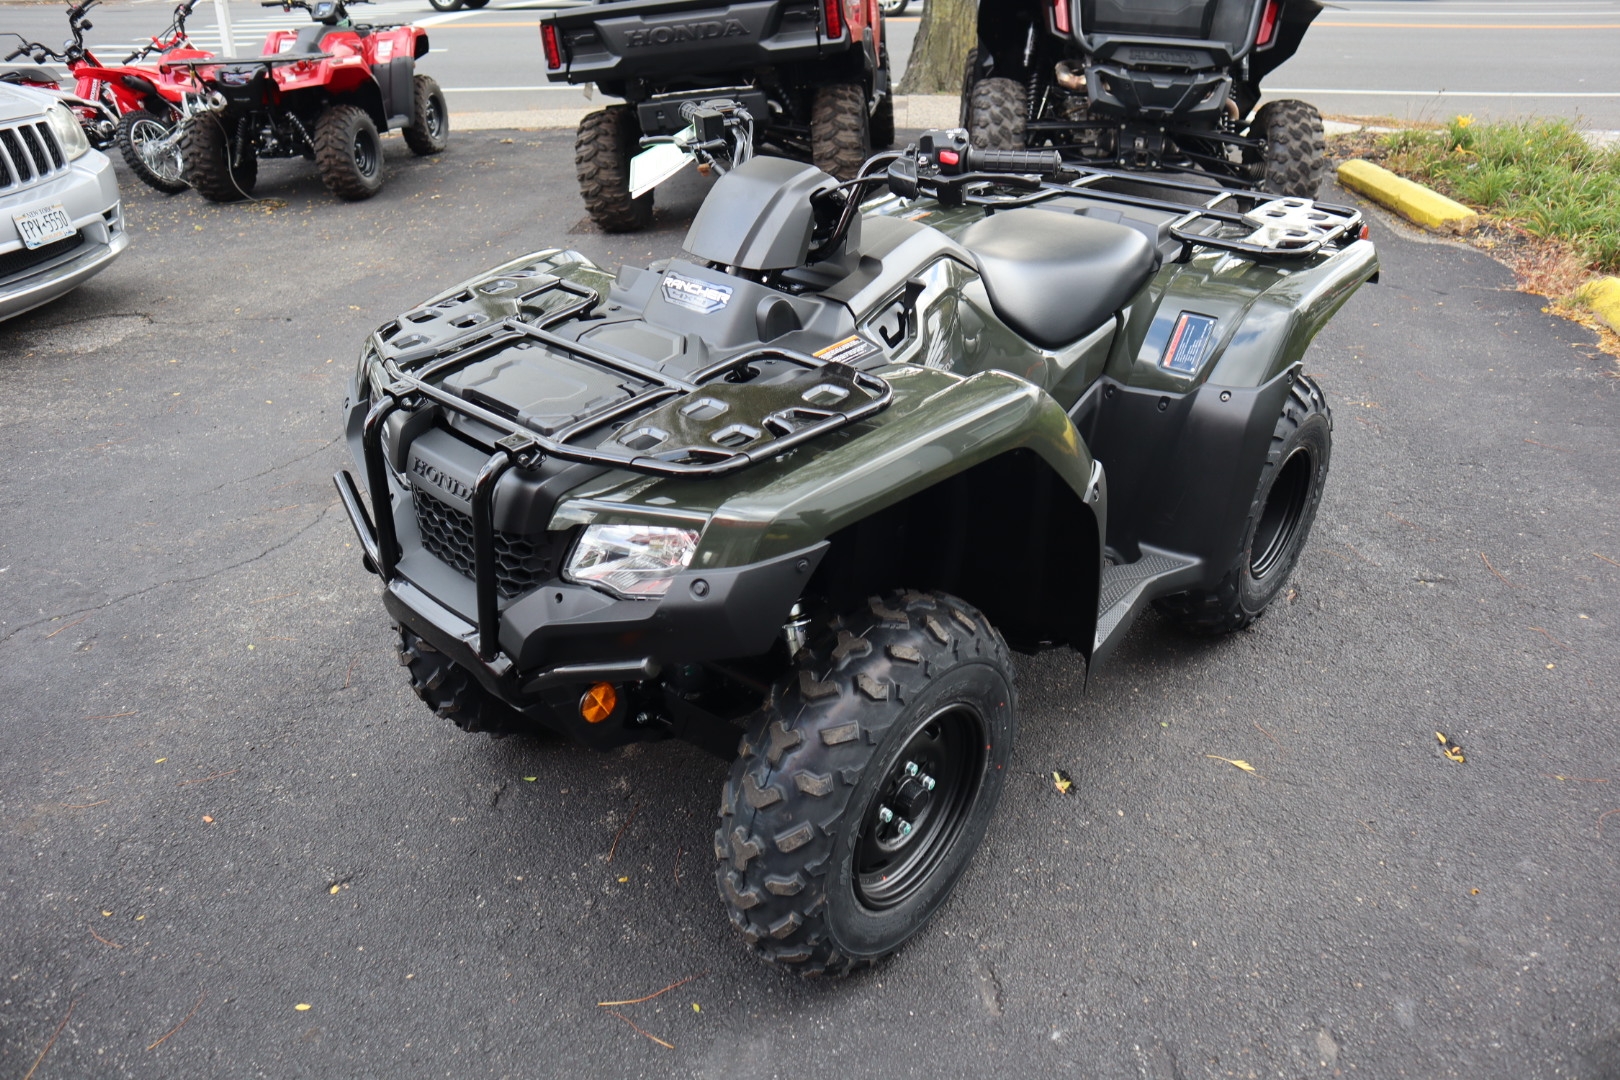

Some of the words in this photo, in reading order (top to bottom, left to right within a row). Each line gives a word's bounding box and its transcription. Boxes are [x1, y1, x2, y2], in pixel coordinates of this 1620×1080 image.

[624, 18, 750, 47] HONDA
[1129, 50, 1198, 64] HONDA
[21, 219, 44, 239] FPV
[43, 210, 69, 232] 5550
[26, 210, 39, 219] NEW
[39, 205, 52, 215] YORK
[663, 277, 730, 304] RANCHER
